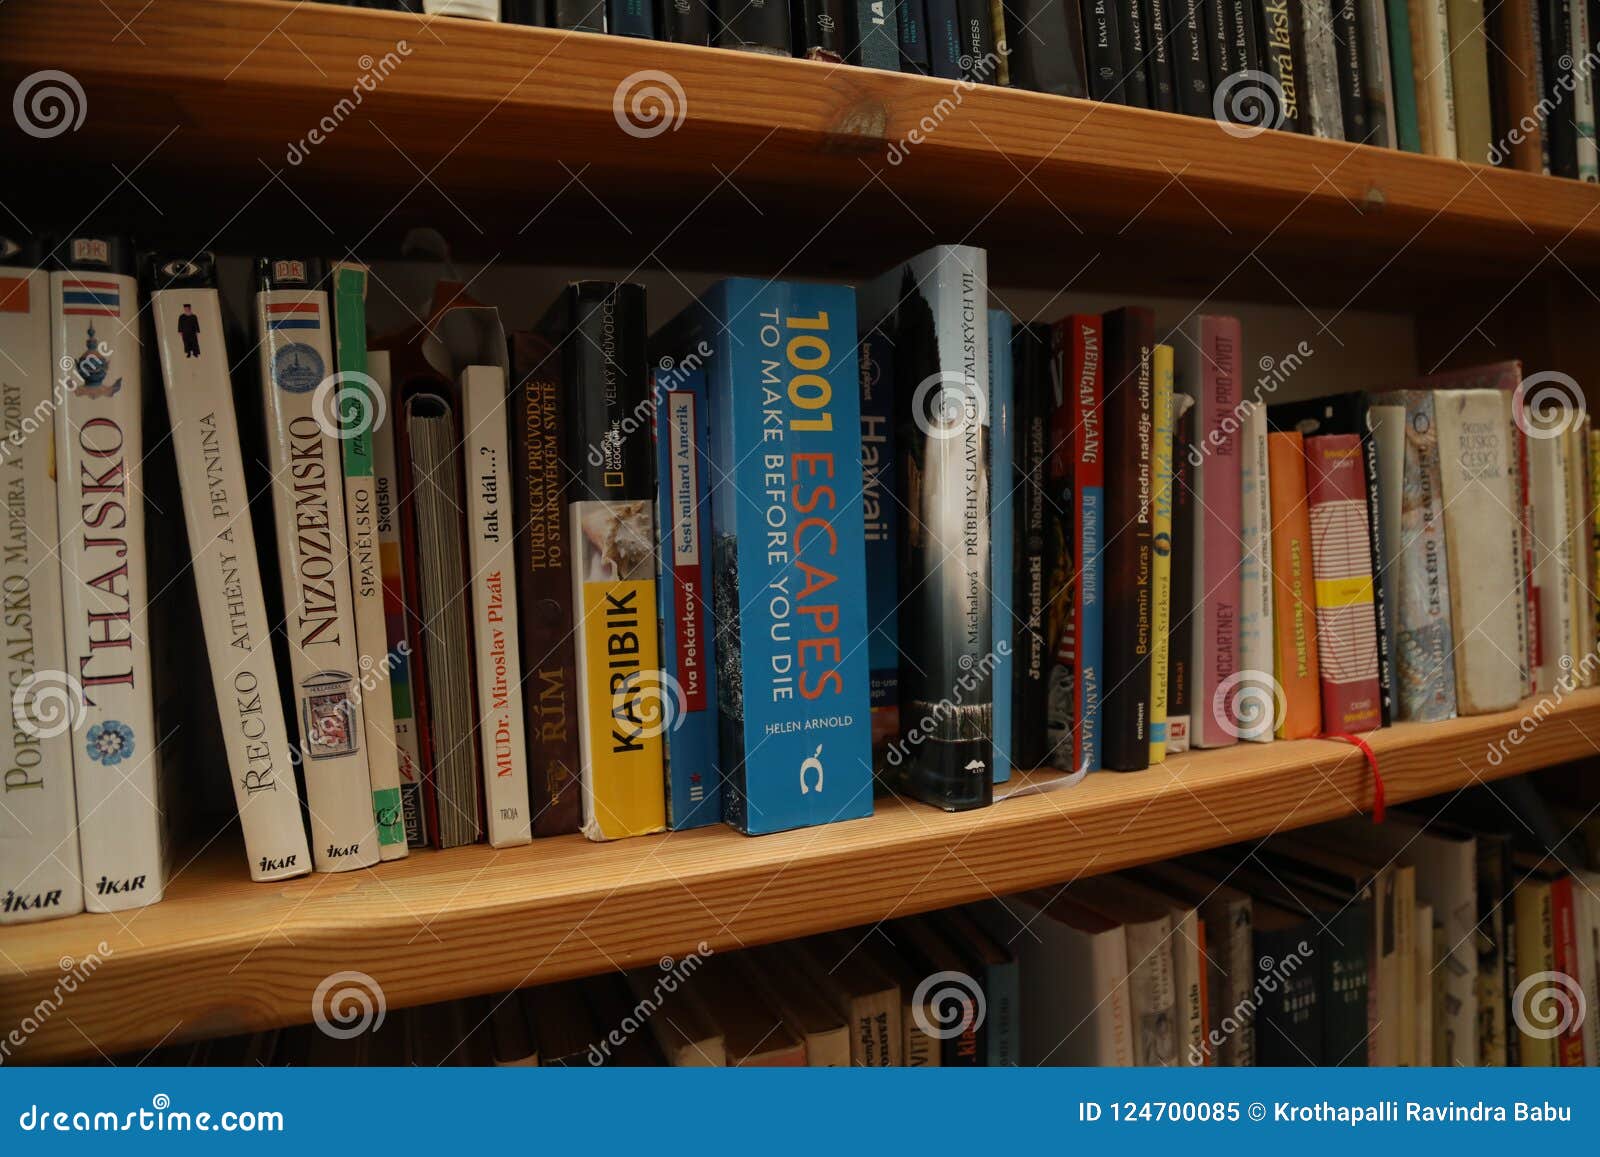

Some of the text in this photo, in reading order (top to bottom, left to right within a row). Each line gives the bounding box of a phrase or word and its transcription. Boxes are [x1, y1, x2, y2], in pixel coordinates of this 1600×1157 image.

[1271, 52, 1299, 120] stará
[601, 299, 618, 407] VELKÝ PRŮVODCE
[961, 300, 976, 387] ITALSKÝCH
[1079, 324, 1098, 464] AMERICAN SLANG
[1213, 335, 1234, 374] ŽIVOT
[1215, 377, 1233, 404] PRO
[525, 381, 547, 572] TURISTICKÝ PRŮVODCE
[675, 404, 693, 553] Šest miliard Amerik
[860, 415, 888, 541] Hawaii
[961, 396, 978, 483] SLAVNÝCH
[287, 415, 341, 648] NIZOZEMSKO
[355, 488, 376, 597] ŠPANĚLSKO
[376, 477, 392, 533] Skotsko
[483, 509, 499, 543] Jak
[759, 308, 793, 703] TO MAKE BEFORE YOU DIE
[785, 310, 844, 700] 1001 ESCAPES
[963, 486, 979, 557] PŘÍBĚHY
[1135, 346, 1150, 656] Benjamin Kuras Poslední naděje civilizace
[1, 384, 44, 794] PORTUGALSKO MADEIRA A AZORY
[79, 416, 136, 706] THAJSKO
[200, 411, 278, 796] ŘECKO ATHÉNY A PEVNINA
[549, 545, 562, 569] PO
[966, 570, 979, 645] Máchalová
[1423, 540, 1440, 617] ČESKÉHO
[605, 590, 644, 753] KARIBIK
[682, 581, 699, 696] Iva Pekárková
[1028, 554, 1044, 681] Jerzy Kosinski
[1215, 602, 1234, 683] MCCARTNEY
[486, 570, 513, 778] MUDr. Miroslav Plzák
[533, 667, 568, 744] ŘÍM
[765, 715, 853, 735] HELEN ARNOLD
[1081, 666, 1099, 714] WANG
[404, 786, 419, 842] MERIAN
